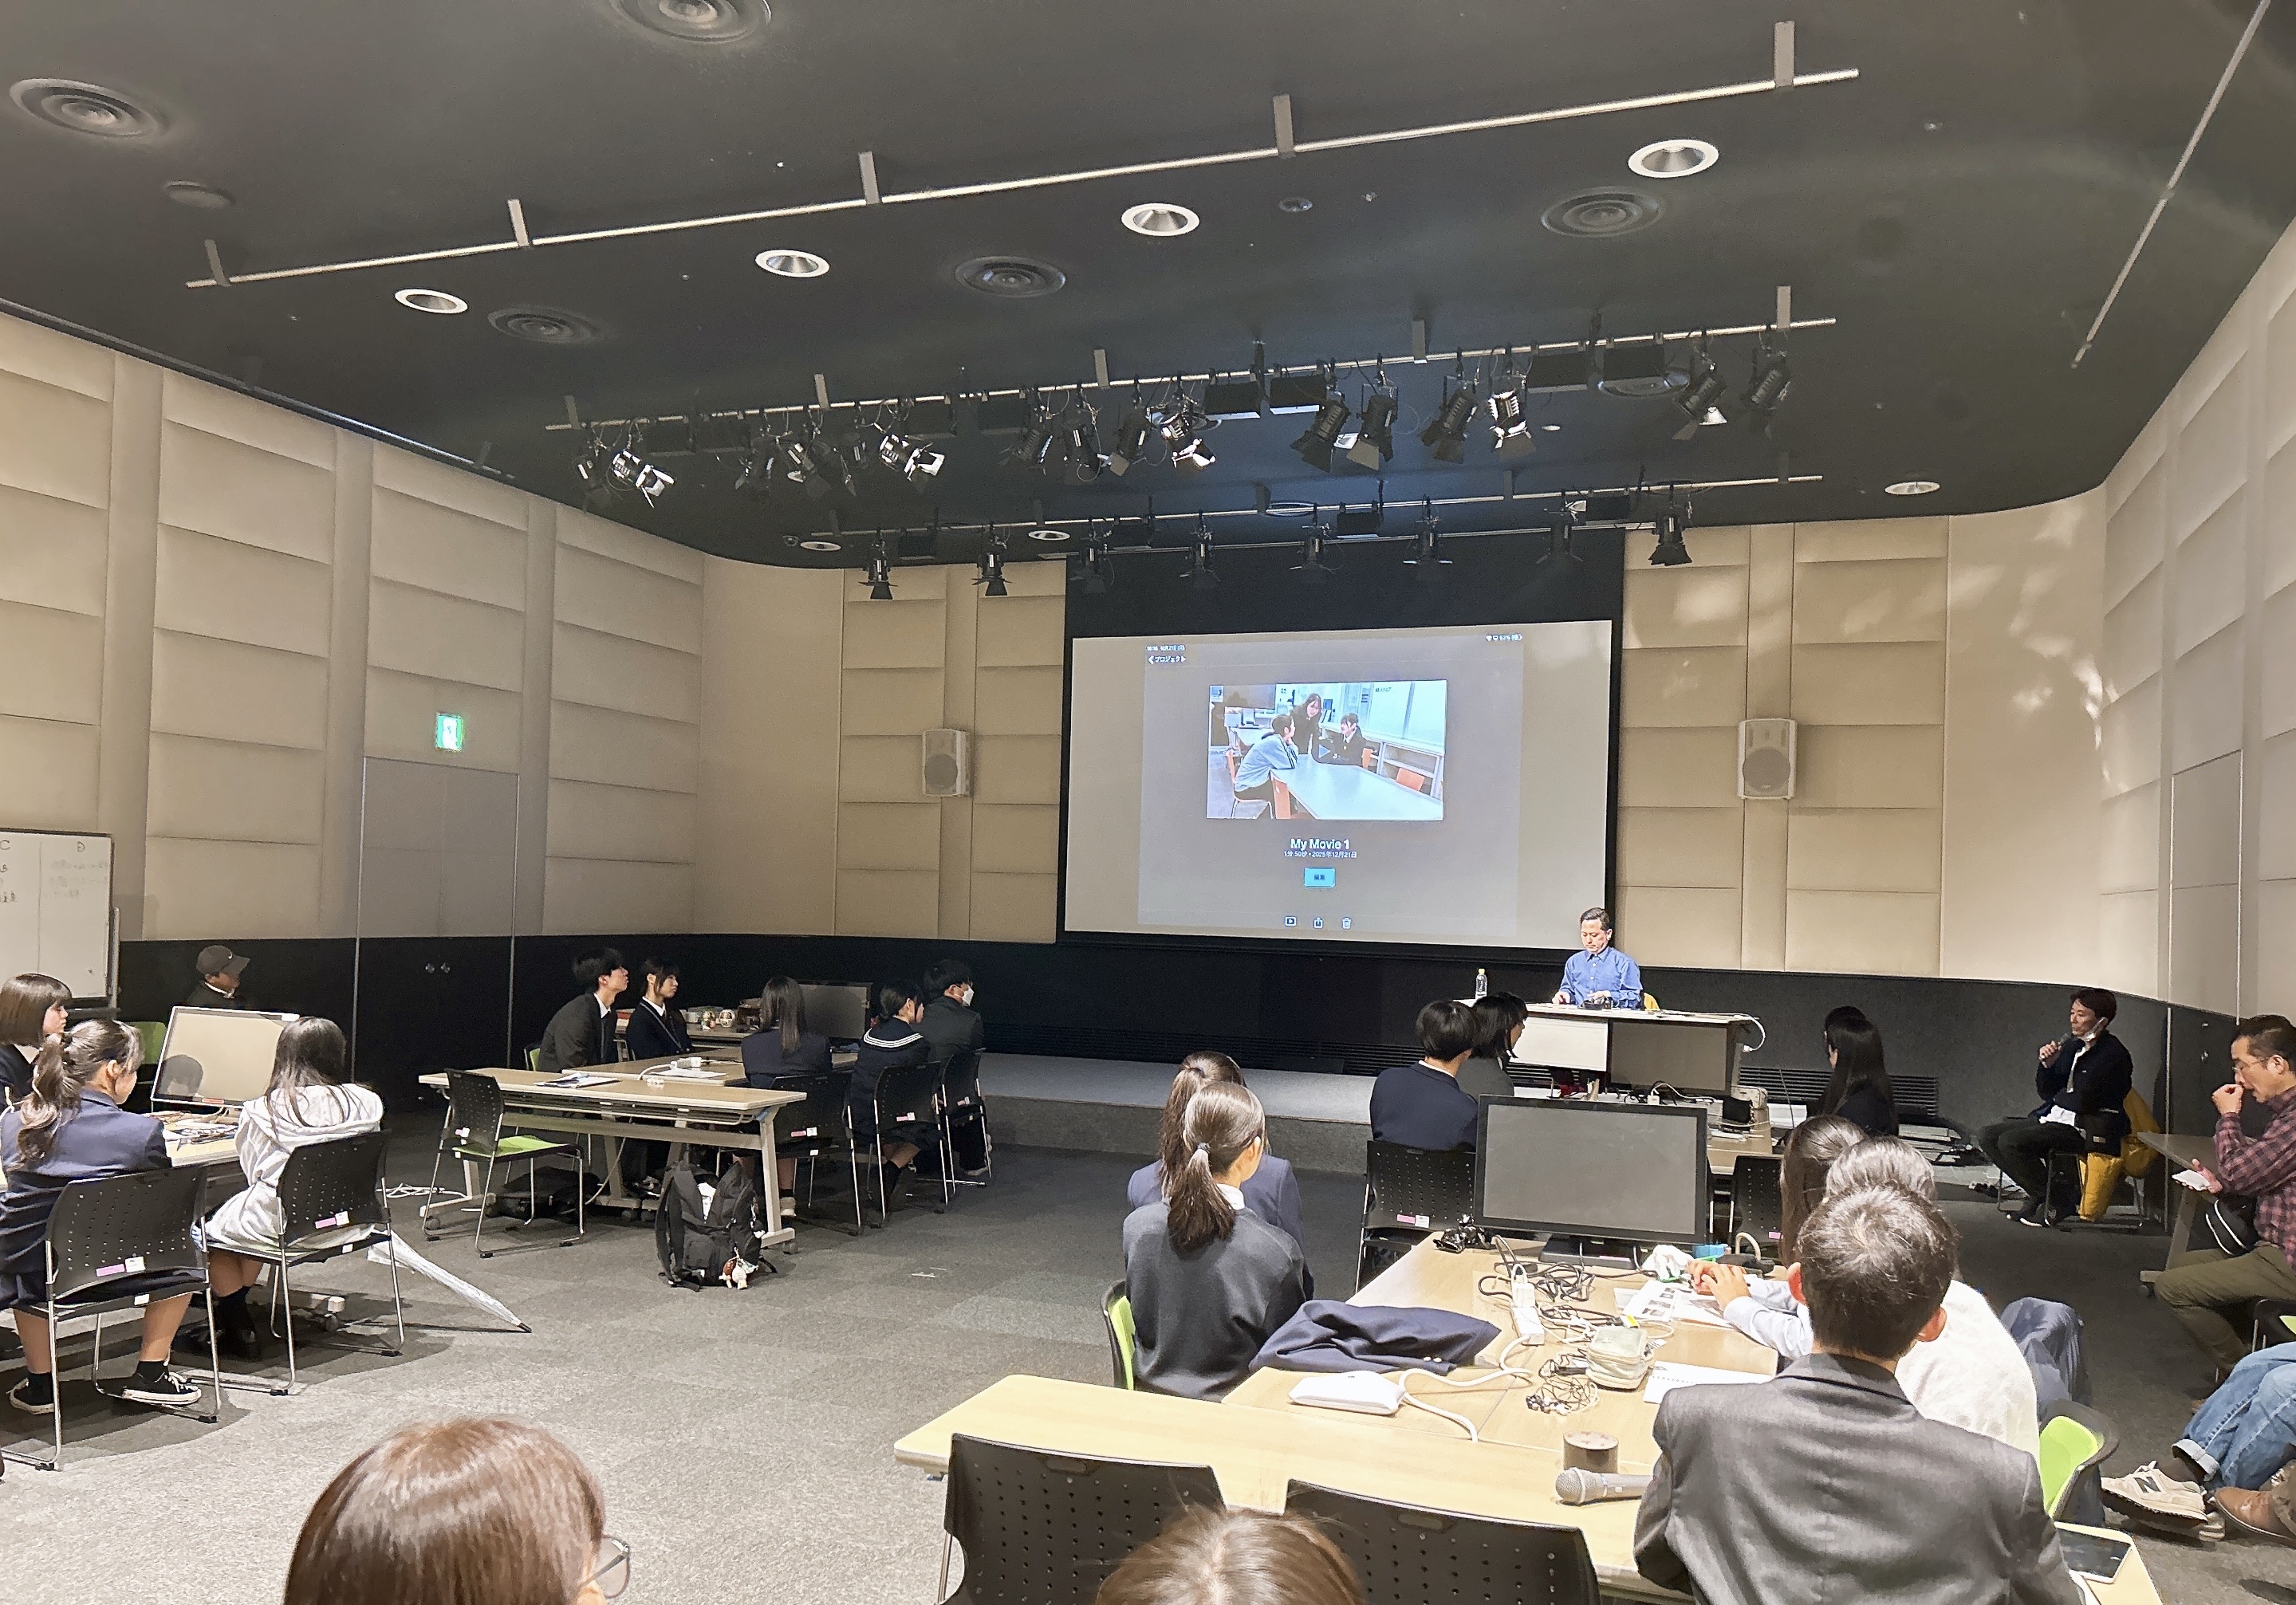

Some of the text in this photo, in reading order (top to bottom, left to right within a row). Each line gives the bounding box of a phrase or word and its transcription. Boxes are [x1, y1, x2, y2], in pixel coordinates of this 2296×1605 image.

[1290, 838, 1350, 851] My Movie 1
[2133, 1476, 2161, 1494] N
